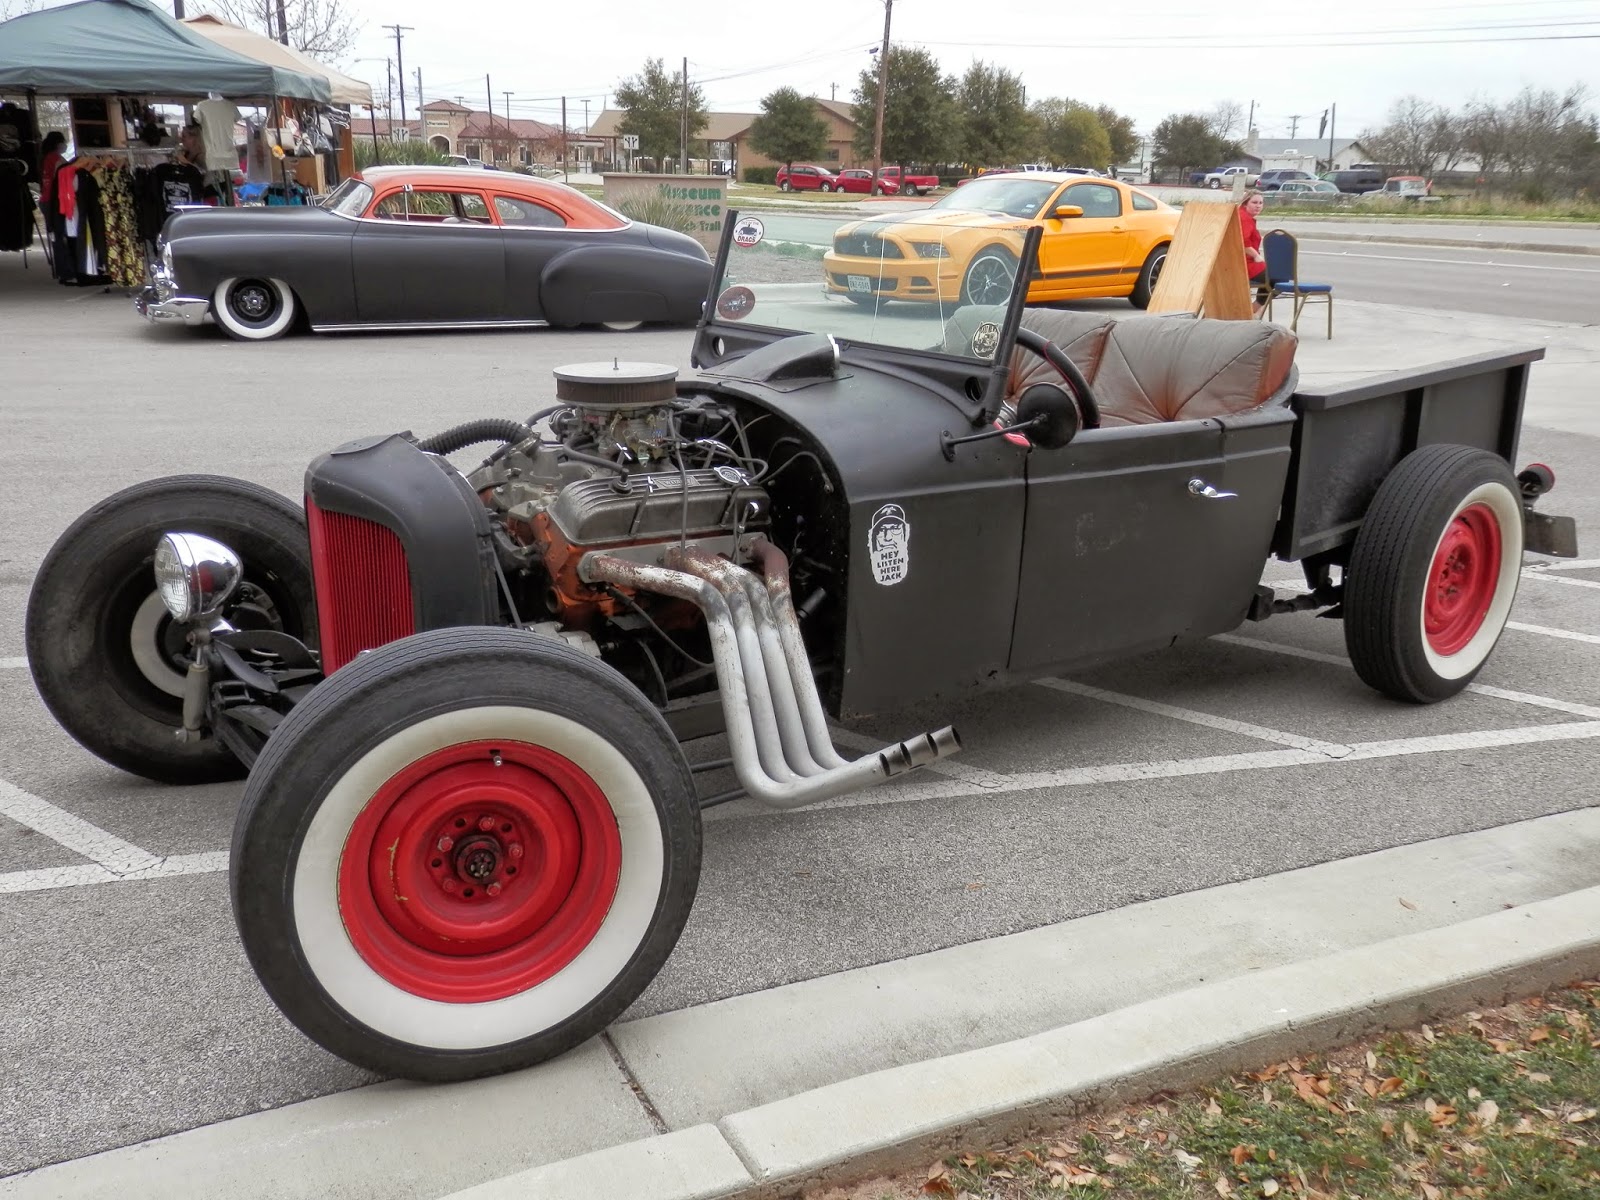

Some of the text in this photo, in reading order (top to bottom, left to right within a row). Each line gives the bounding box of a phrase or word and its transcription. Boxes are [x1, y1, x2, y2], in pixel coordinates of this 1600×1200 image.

[658, 183, 721, 200] Museum
[737, 235, 756, 243] DRAGS
[881, 550, 899, 560] HEY
[877, 557, 904, 568] LISTEN
[880, 565, 901, 575] HERE
[880, 572, 902, 582] JACK
